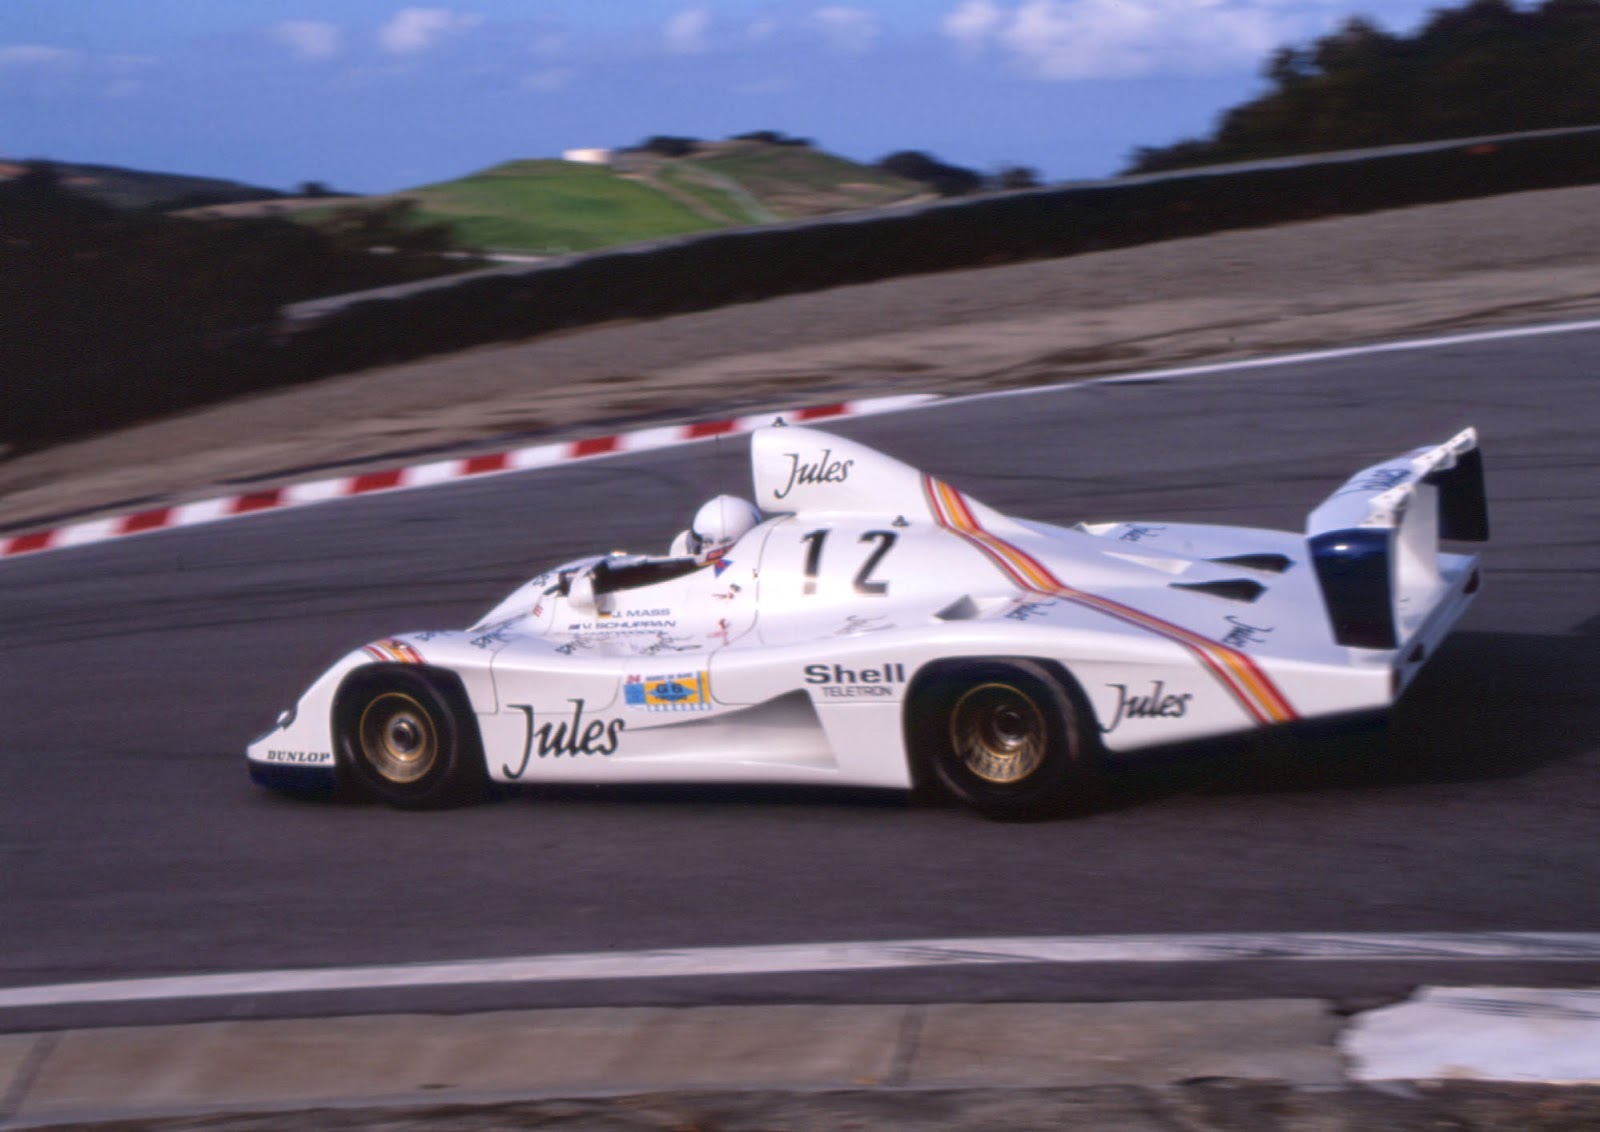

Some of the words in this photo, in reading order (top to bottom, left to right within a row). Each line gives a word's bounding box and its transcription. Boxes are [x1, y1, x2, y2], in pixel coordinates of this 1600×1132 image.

[773, 449, 854, 500] Jules
[801, 528, 899, 596] 12
[626, 608, 671, 617] MASS
[595, 620, 677, 629] SCHUPPAN
[803, 663, 905, 684] Shell
[821, 685, 893, 698] TELETRON
[1100, 680, 1194, 733] Jules
[502, 698, 626, 780] Jules
[267, 749, 331, 762] DUNLOP
